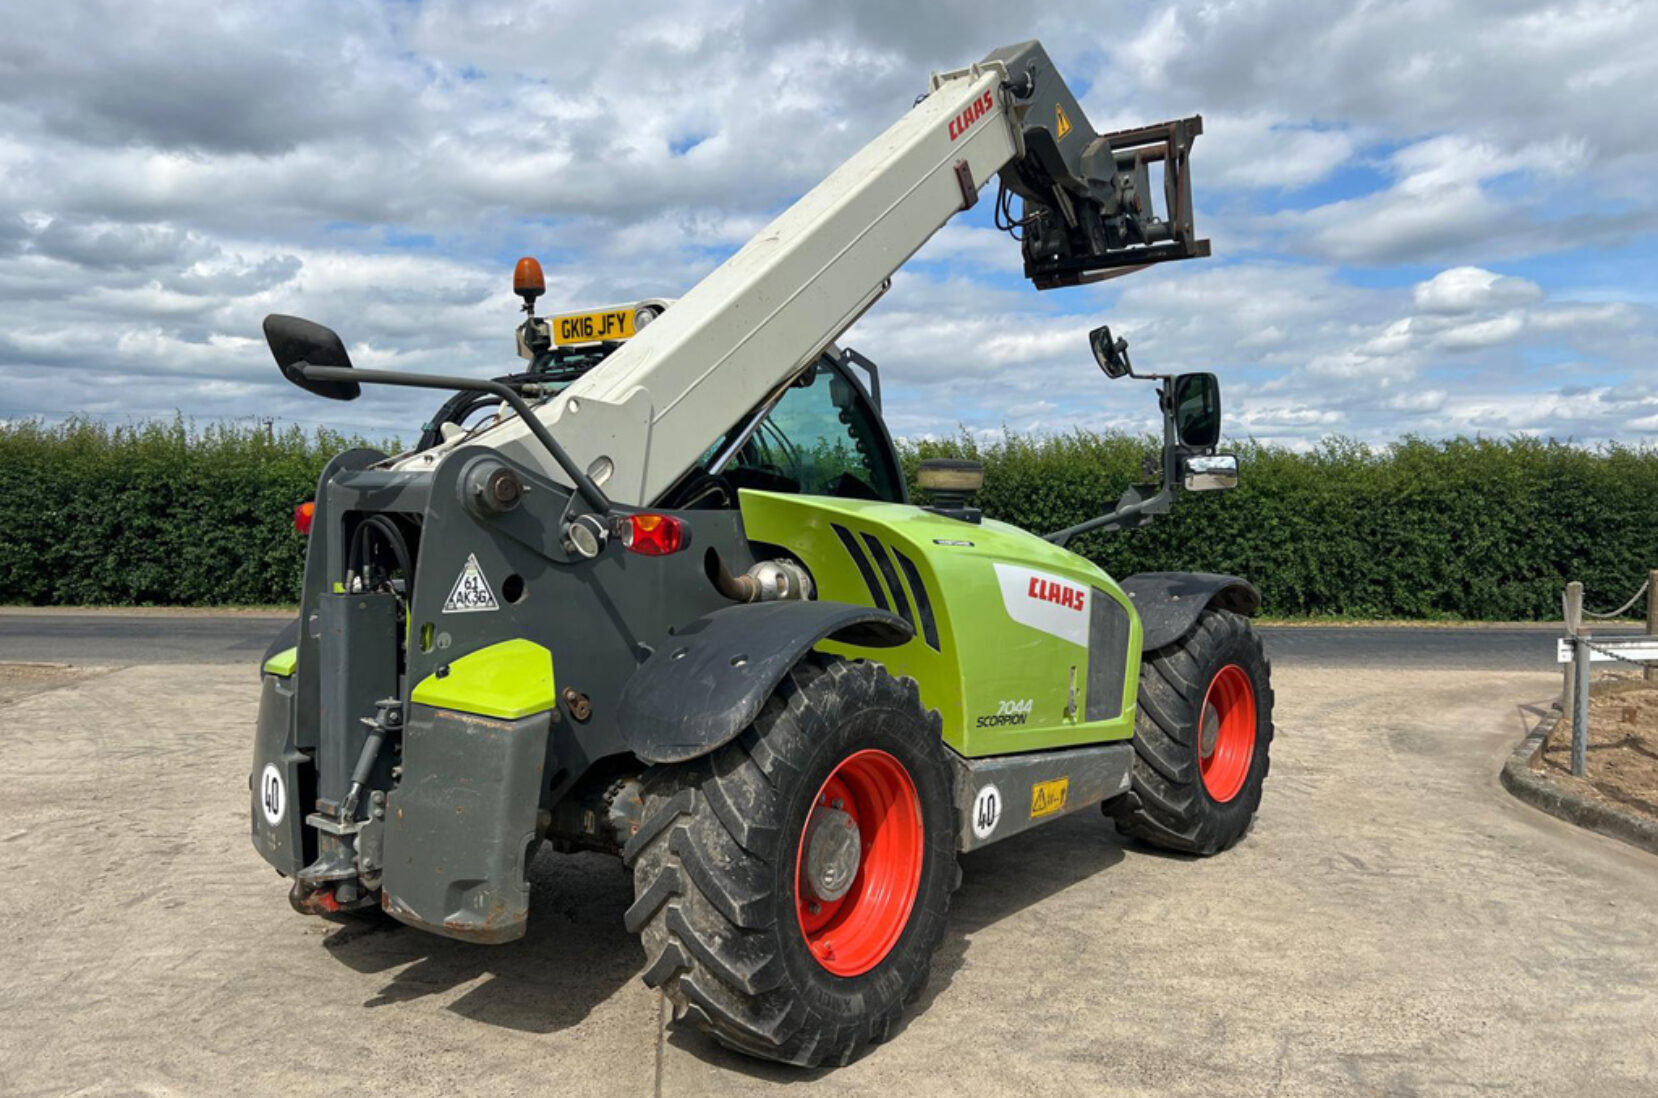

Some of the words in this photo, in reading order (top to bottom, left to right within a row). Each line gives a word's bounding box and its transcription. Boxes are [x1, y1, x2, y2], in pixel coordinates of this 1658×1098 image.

[948, 89, 993, 142] CLAAS
[561, 316, 594, 339] GK16
[598, 312, 627, 335] JFY
[464, 576, 479, 590] 61
[1028, 576, 1085, 612] CLAAS
[976, 714, 1027, 728] SCORPION
[996, 699, 1034, 715] 7044
[265, 773, 279, 815] 40
[977, 794, 996, 830] 40
